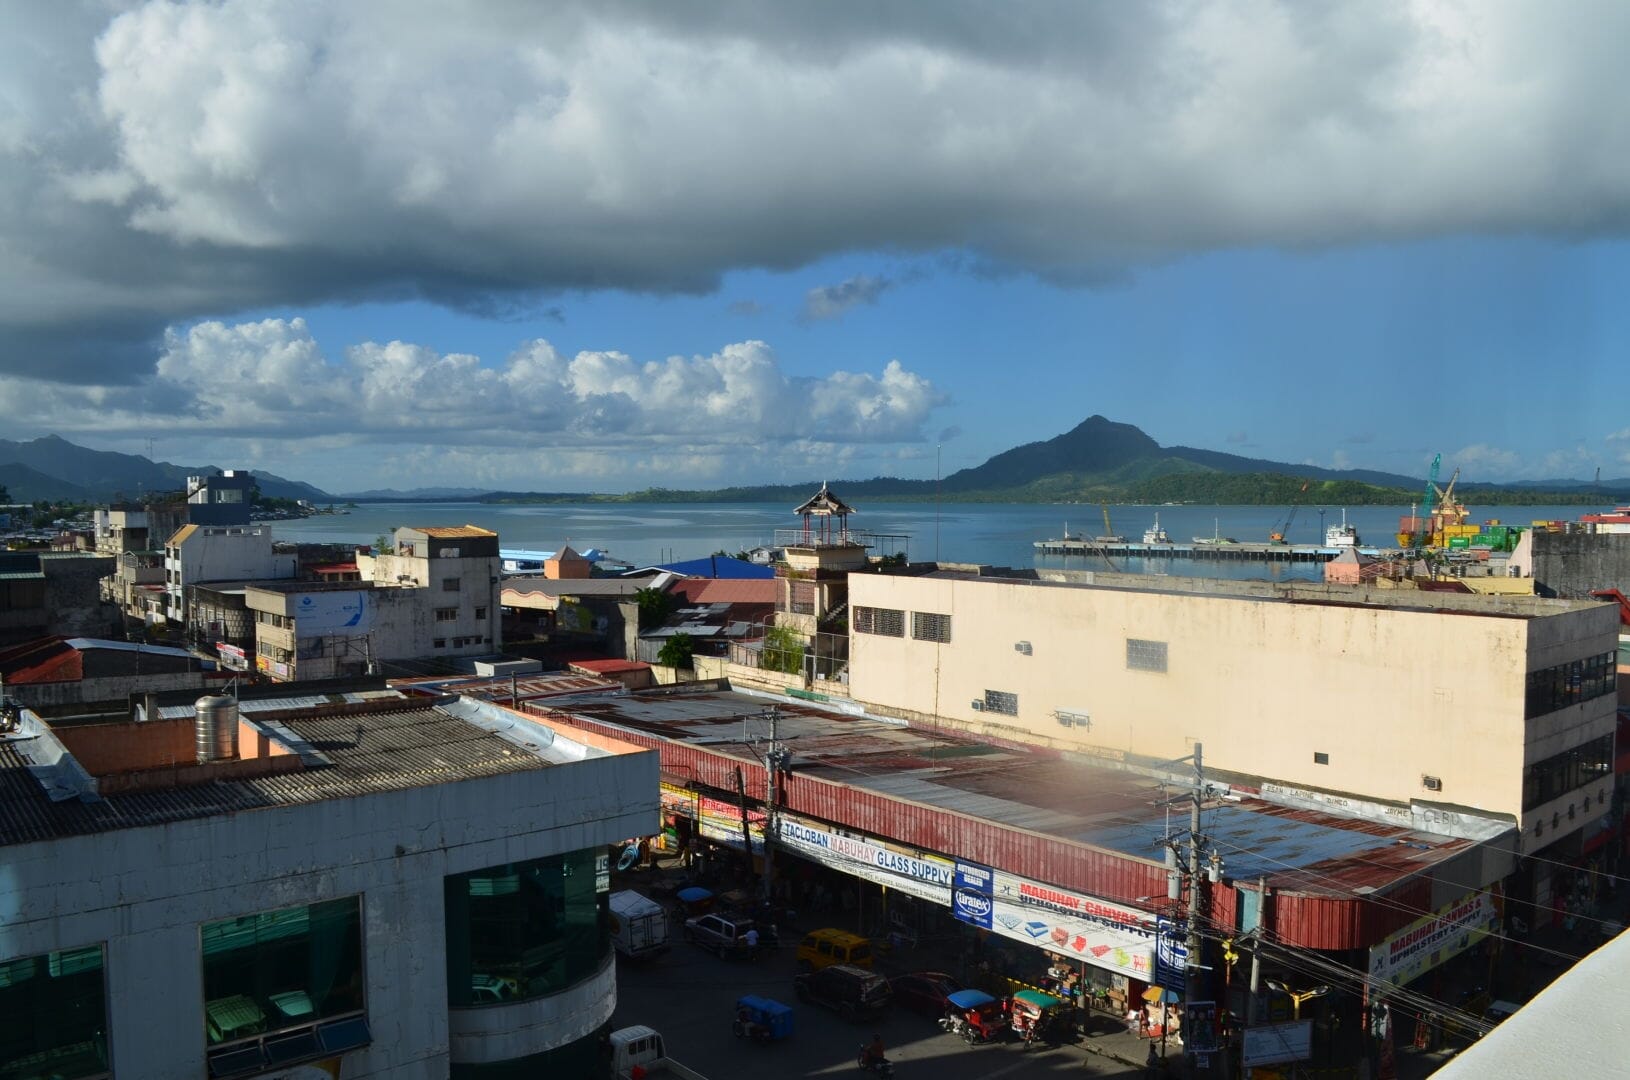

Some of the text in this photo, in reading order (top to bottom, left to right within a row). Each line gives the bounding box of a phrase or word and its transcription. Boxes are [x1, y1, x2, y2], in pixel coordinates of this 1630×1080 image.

[1423, 808, 1460, 826] CEBU
[785, 823, 828, 849] TACLOBAN
[830, 837, 876, 863] MABUHAY
[877, 851, 909, 874] GLASS
[911, 861, 950, 885] SUPPLY
[1020, 883, 1139, 925] MABUHAY CANVAS
[1389, 927, 1449, 965] UPHOLSTERY
[1390, 920, 1438, 953] MABUHAY
